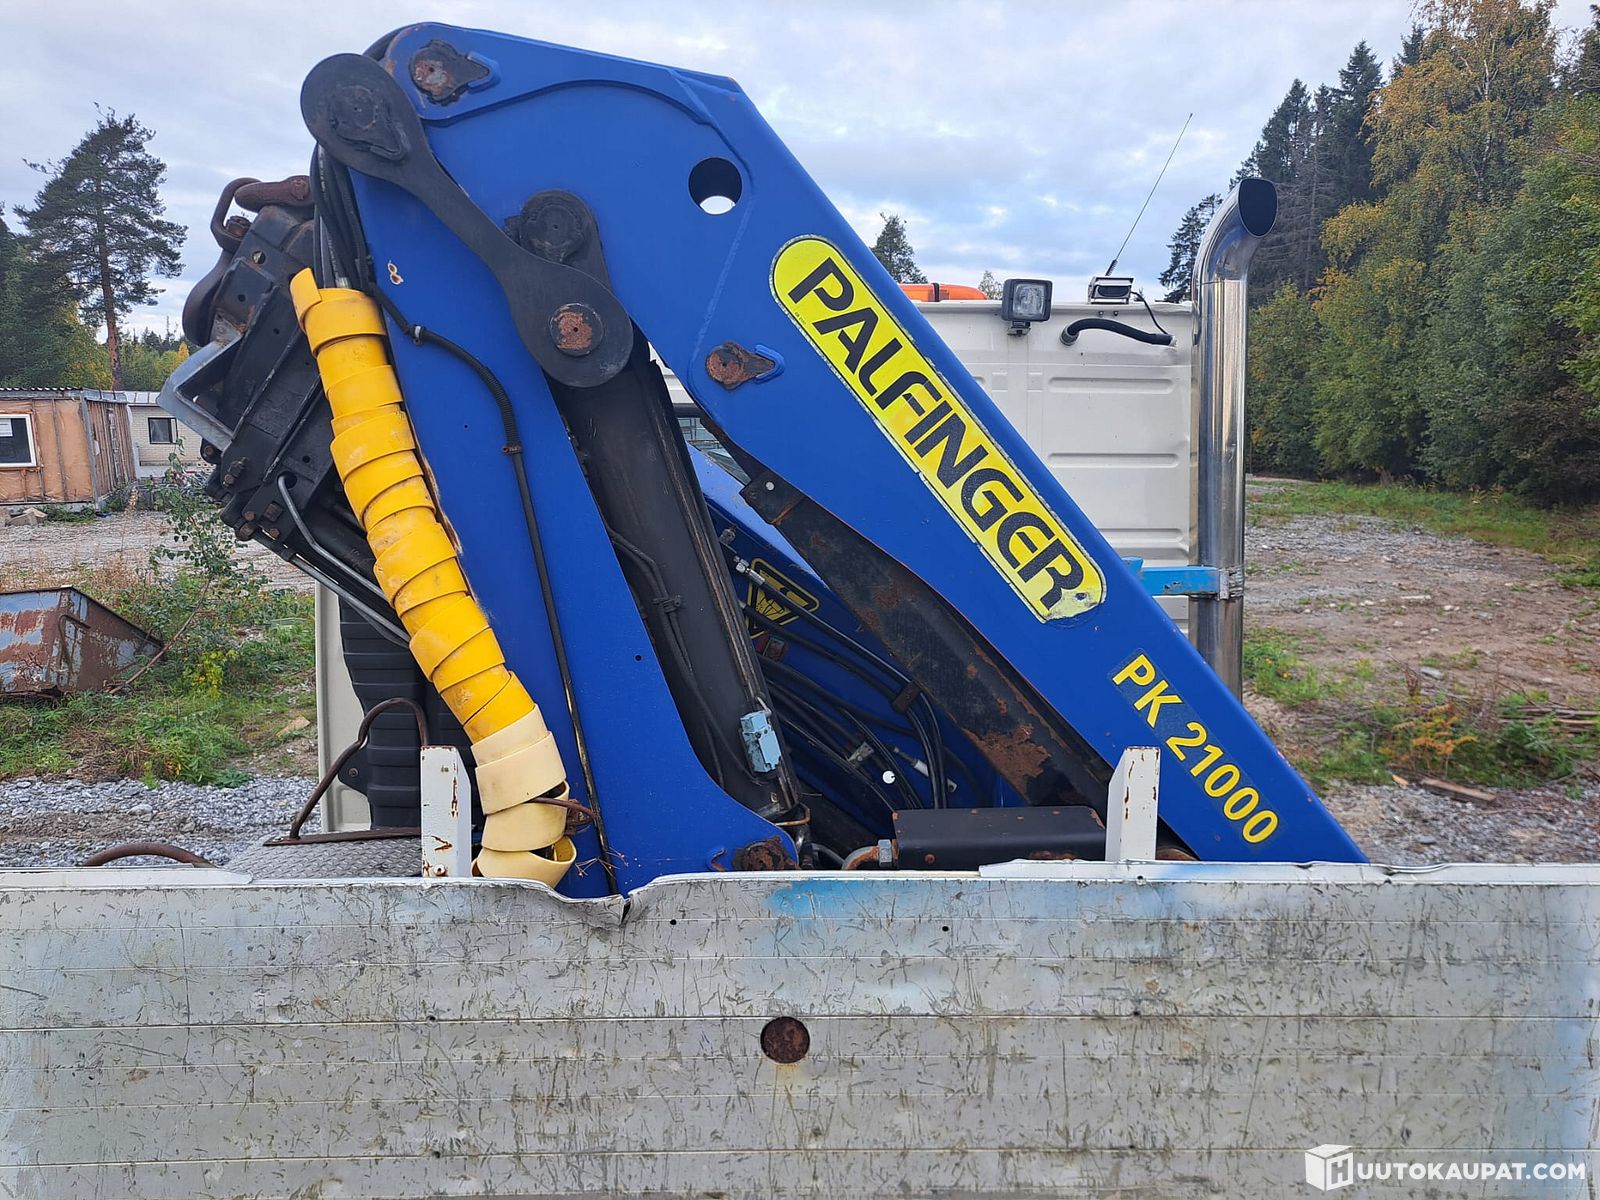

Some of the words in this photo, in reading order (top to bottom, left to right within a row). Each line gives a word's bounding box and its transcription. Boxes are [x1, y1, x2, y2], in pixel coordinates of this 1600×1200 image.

[788, 257, 1084, 610] PALFINGER
[1111, 653, 1183, 728] PK
[1165, 721, 1279, 844] 21000
